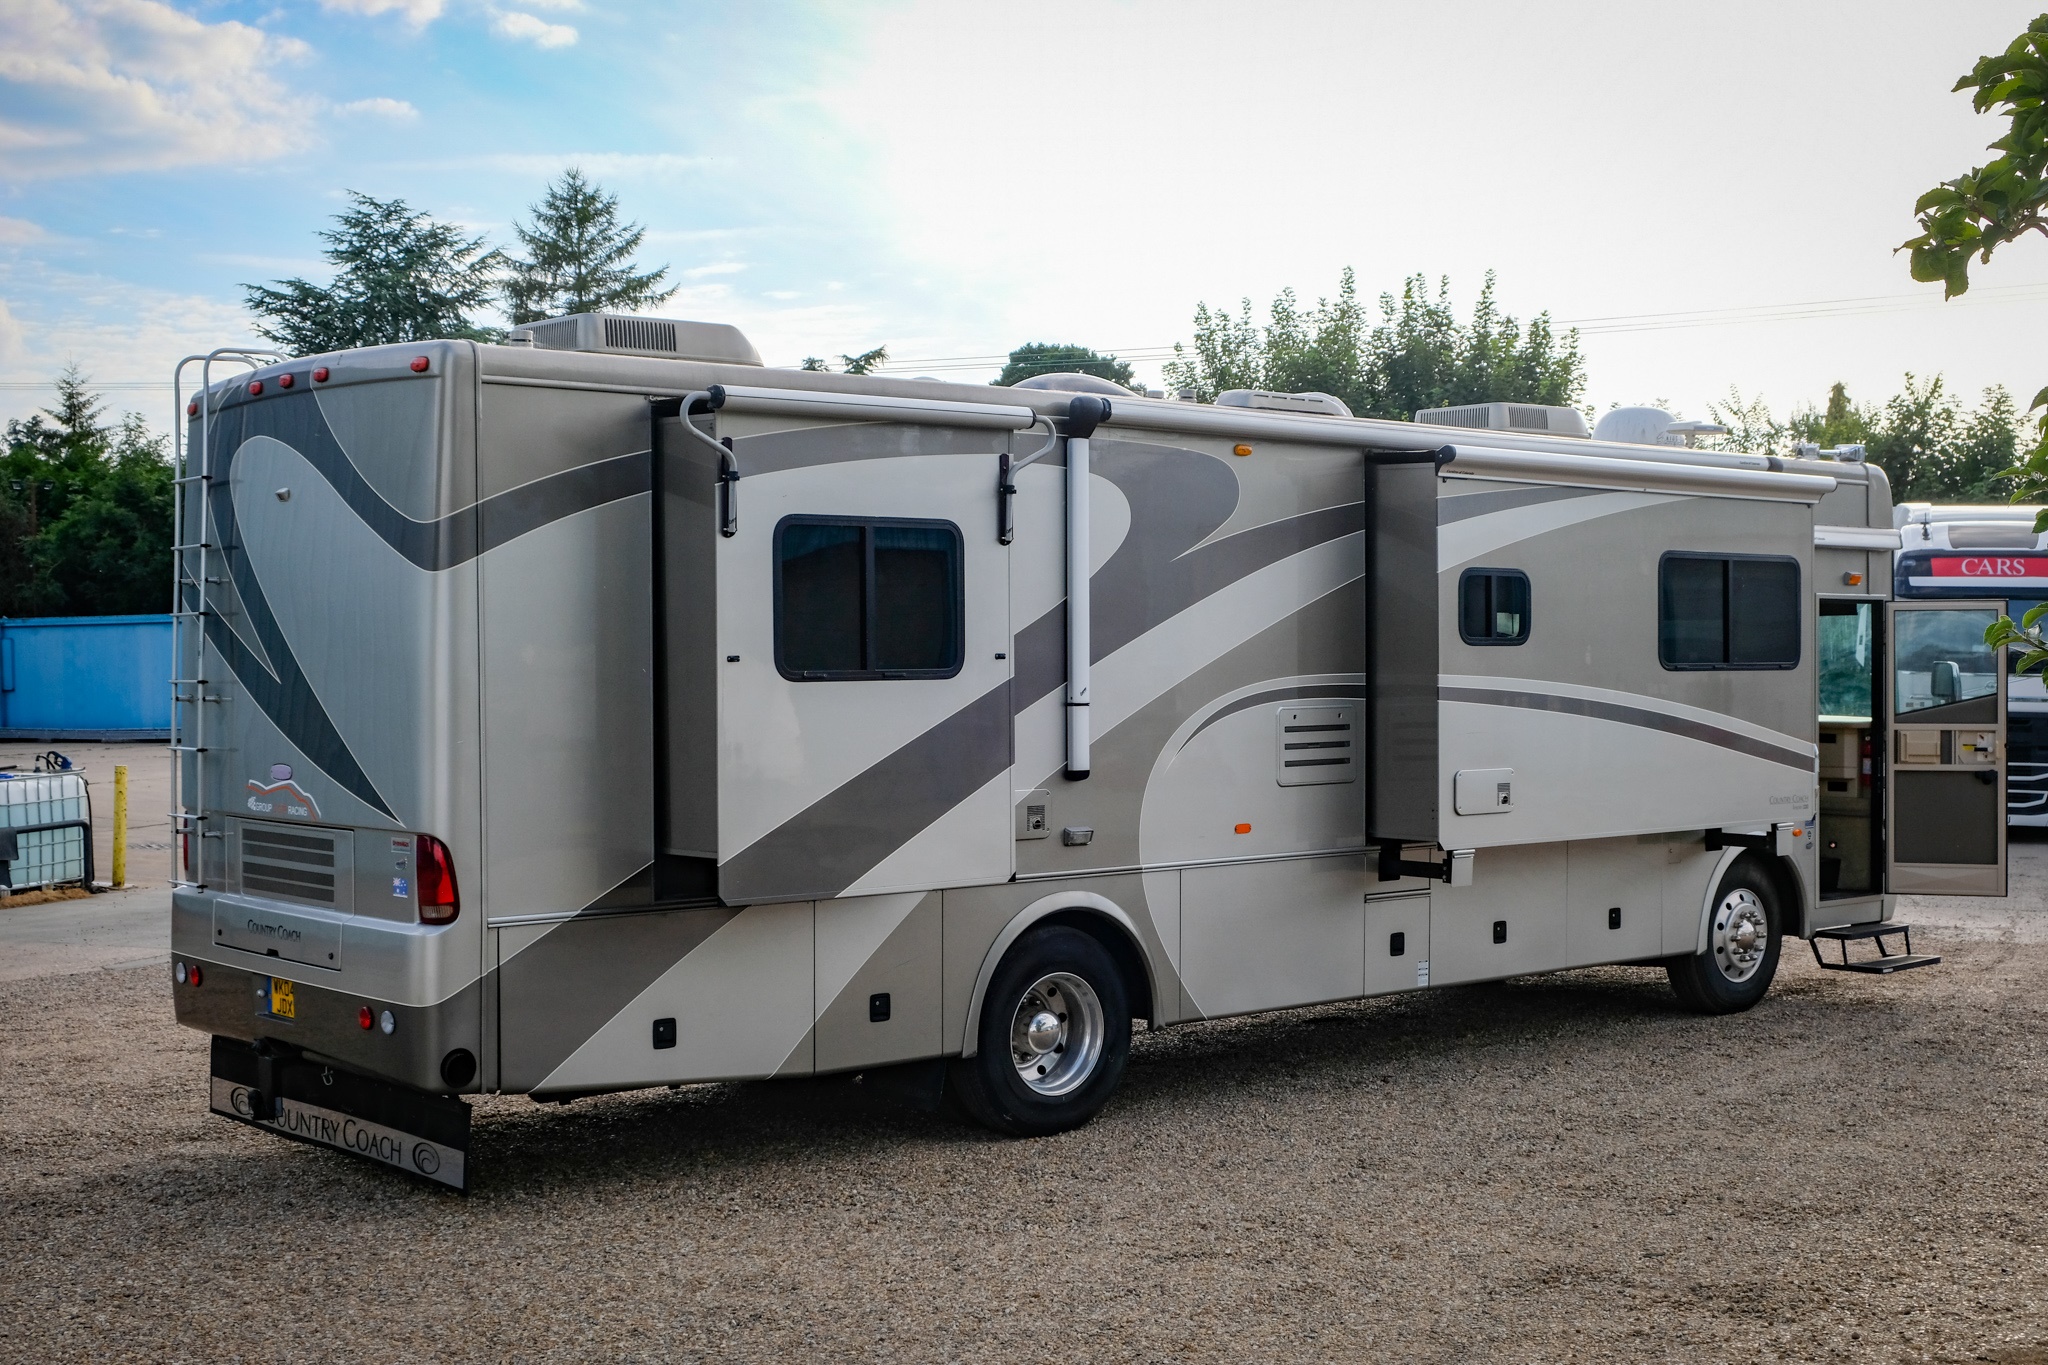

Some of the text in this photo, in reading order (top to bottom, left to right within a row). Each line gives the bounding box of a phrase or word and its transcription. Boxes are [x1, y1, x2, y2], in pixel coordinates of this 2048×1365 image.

[1961, 558, 2025, 576] CARS
[287, 805, 308, 817] RACING
[247, 919, 302, 943] COUNTRY COACH
[277, 998, 294, 1016] JDX
[343, 1119, 402, 1165] COACH
